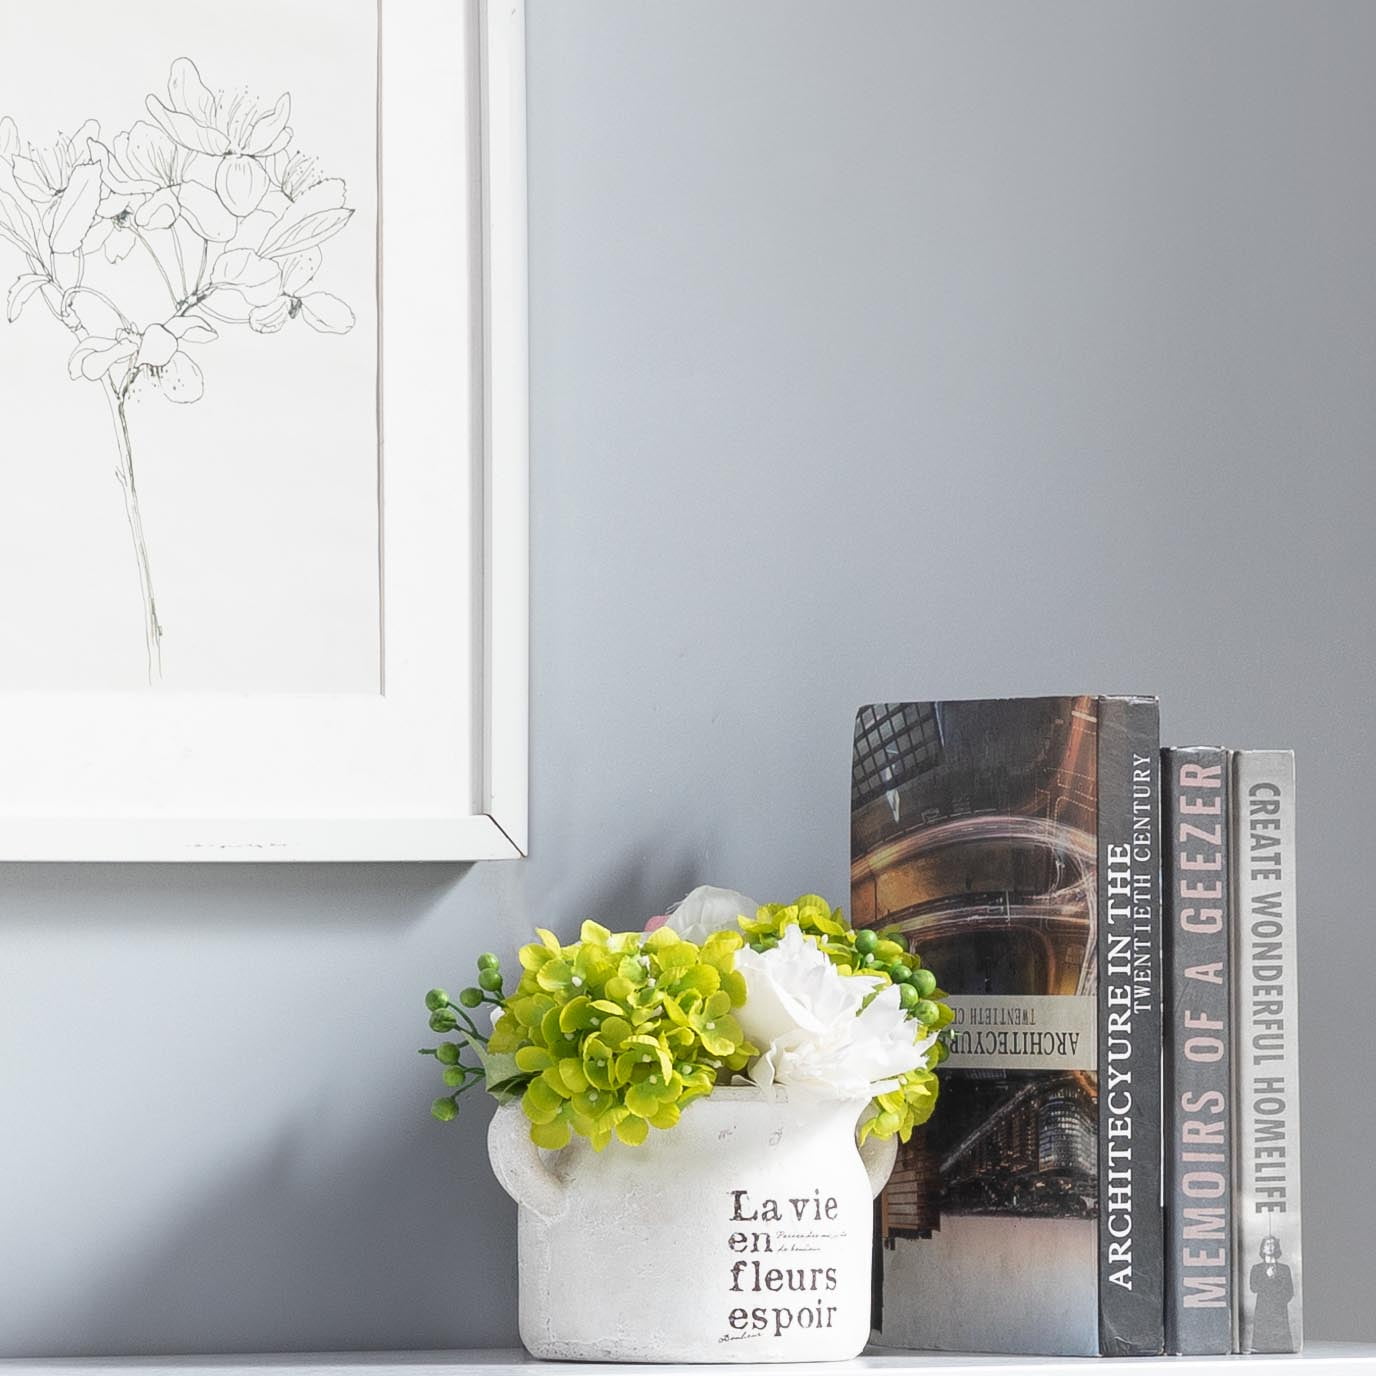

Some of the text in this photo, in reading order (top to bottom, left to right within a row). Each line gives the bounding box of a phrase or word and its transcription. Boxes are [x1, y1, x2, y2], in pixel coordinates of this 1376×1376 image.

[1133, 753, 1152, 1013] TWENTIETH CENTURY
[1248, 782, 1286, 1214] CREATE WONDERFUL HOMELIFE
[969, 1008, 1036, 1025] TWENTIETH
[949, 1031, 1080, 1055] ARCHITECYUR
[1180, 763, 1227, 1308] MEMOIRS OF A GEEZER
[1108, 844, 1132, 1290] ARCHITECYURE IN THE
[728, 1188, 838, 1221] La vie
[728, 1232, 773, 1253] en
[728, 1260, 837, 1292] fleurs
[728, 1298, 837, 1336] espoir
